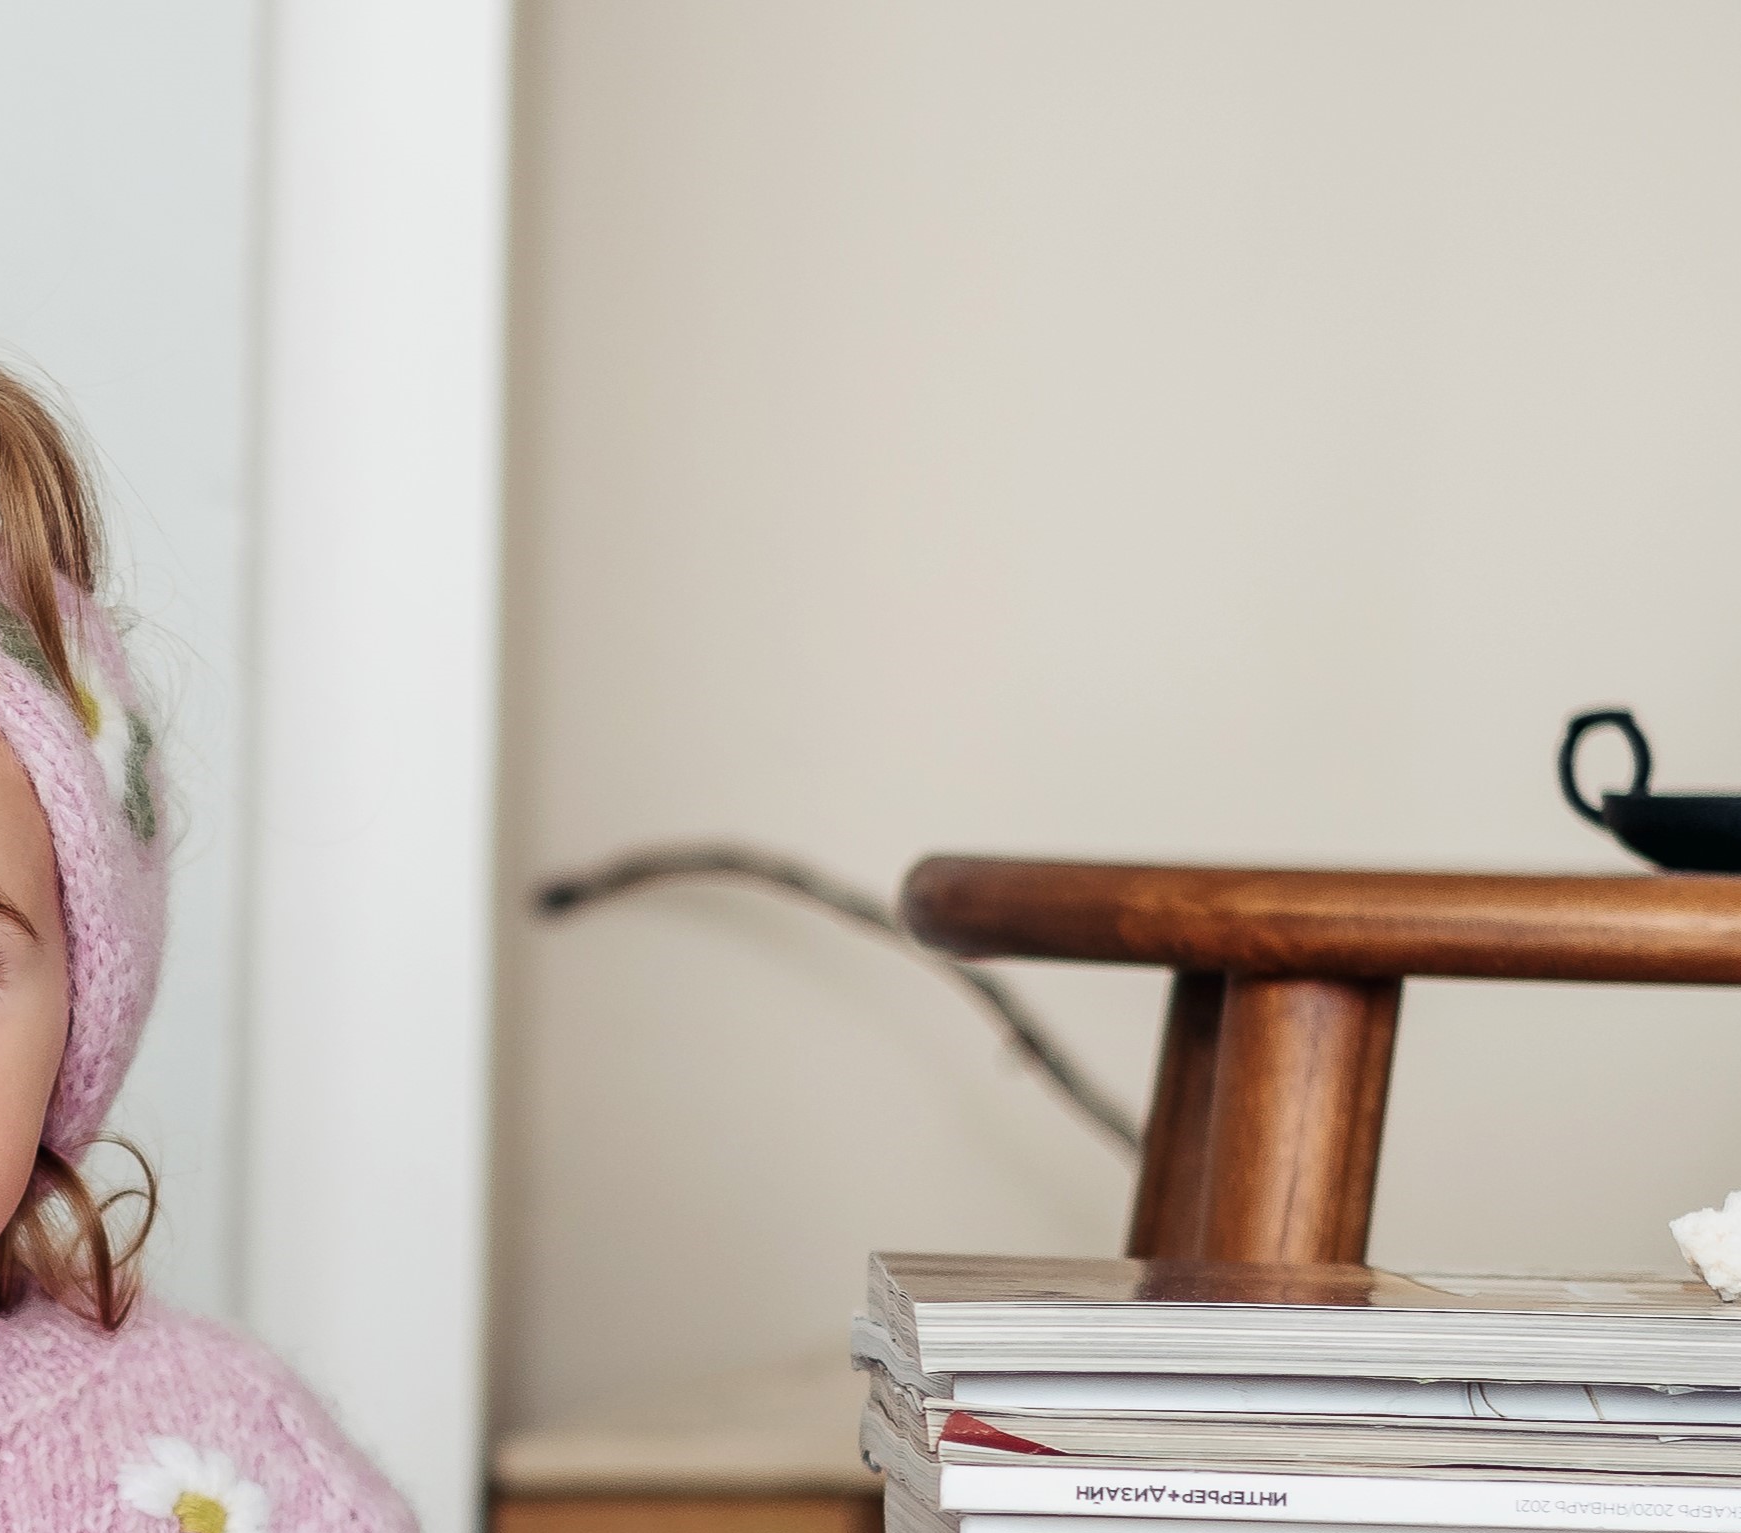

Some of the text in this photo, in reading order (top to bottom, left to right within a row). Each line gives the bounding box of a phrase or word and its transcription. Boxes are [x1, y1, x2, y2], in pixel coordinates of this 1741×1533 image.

[1076, 1485, 1287, 1507] ИНТЕРЬЕР+ДИЗАЙН
[1516, 1499, 1741, 1519] КАБРЬ 2020/ЯНВАРЬ 2021
